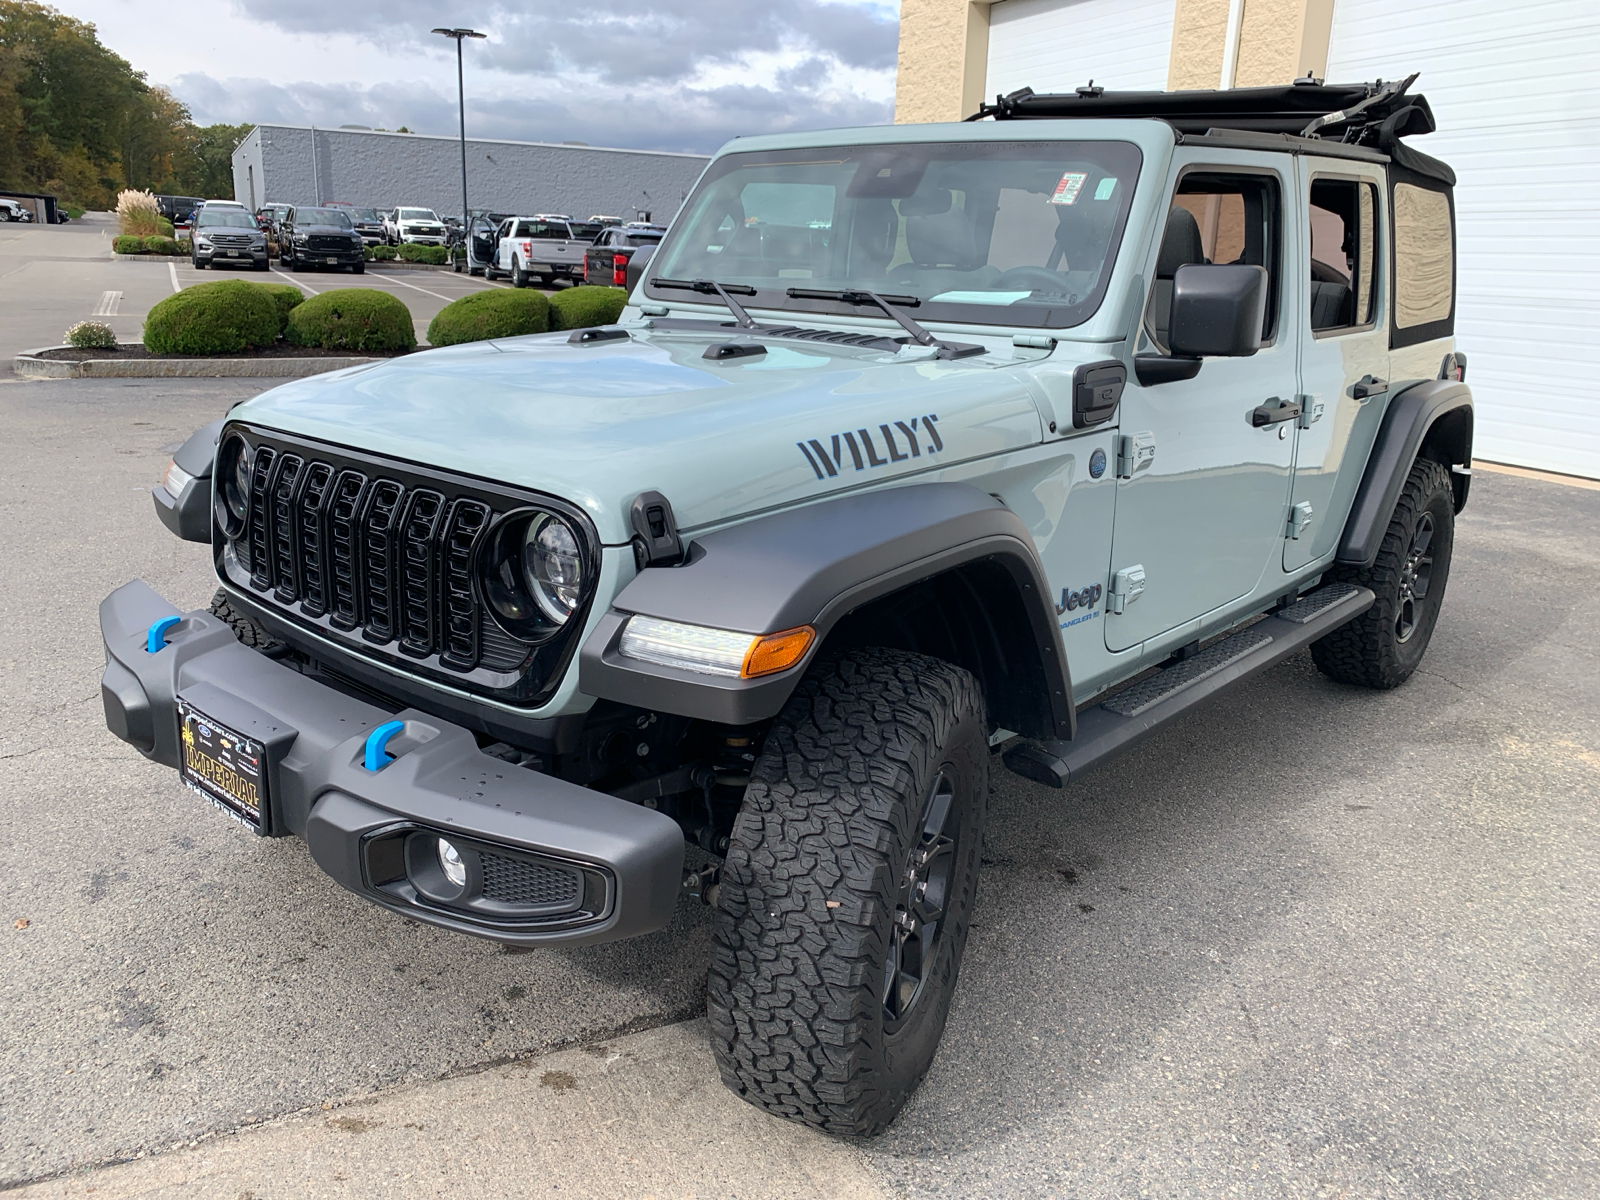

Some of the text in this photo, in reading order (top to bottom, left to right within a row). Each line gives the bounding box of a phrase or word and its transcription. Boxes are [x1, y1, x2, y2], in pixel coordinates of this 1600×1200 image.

[796, 413, 943, 480] WILLYS
[1054, 583, 1102, 615] Jeep
[1060, 612, 1092, 629] ANGLER
[186, 743, 260, 811] IMPERIAL
[187, 767, 260, 818] www.imperialcars.com
